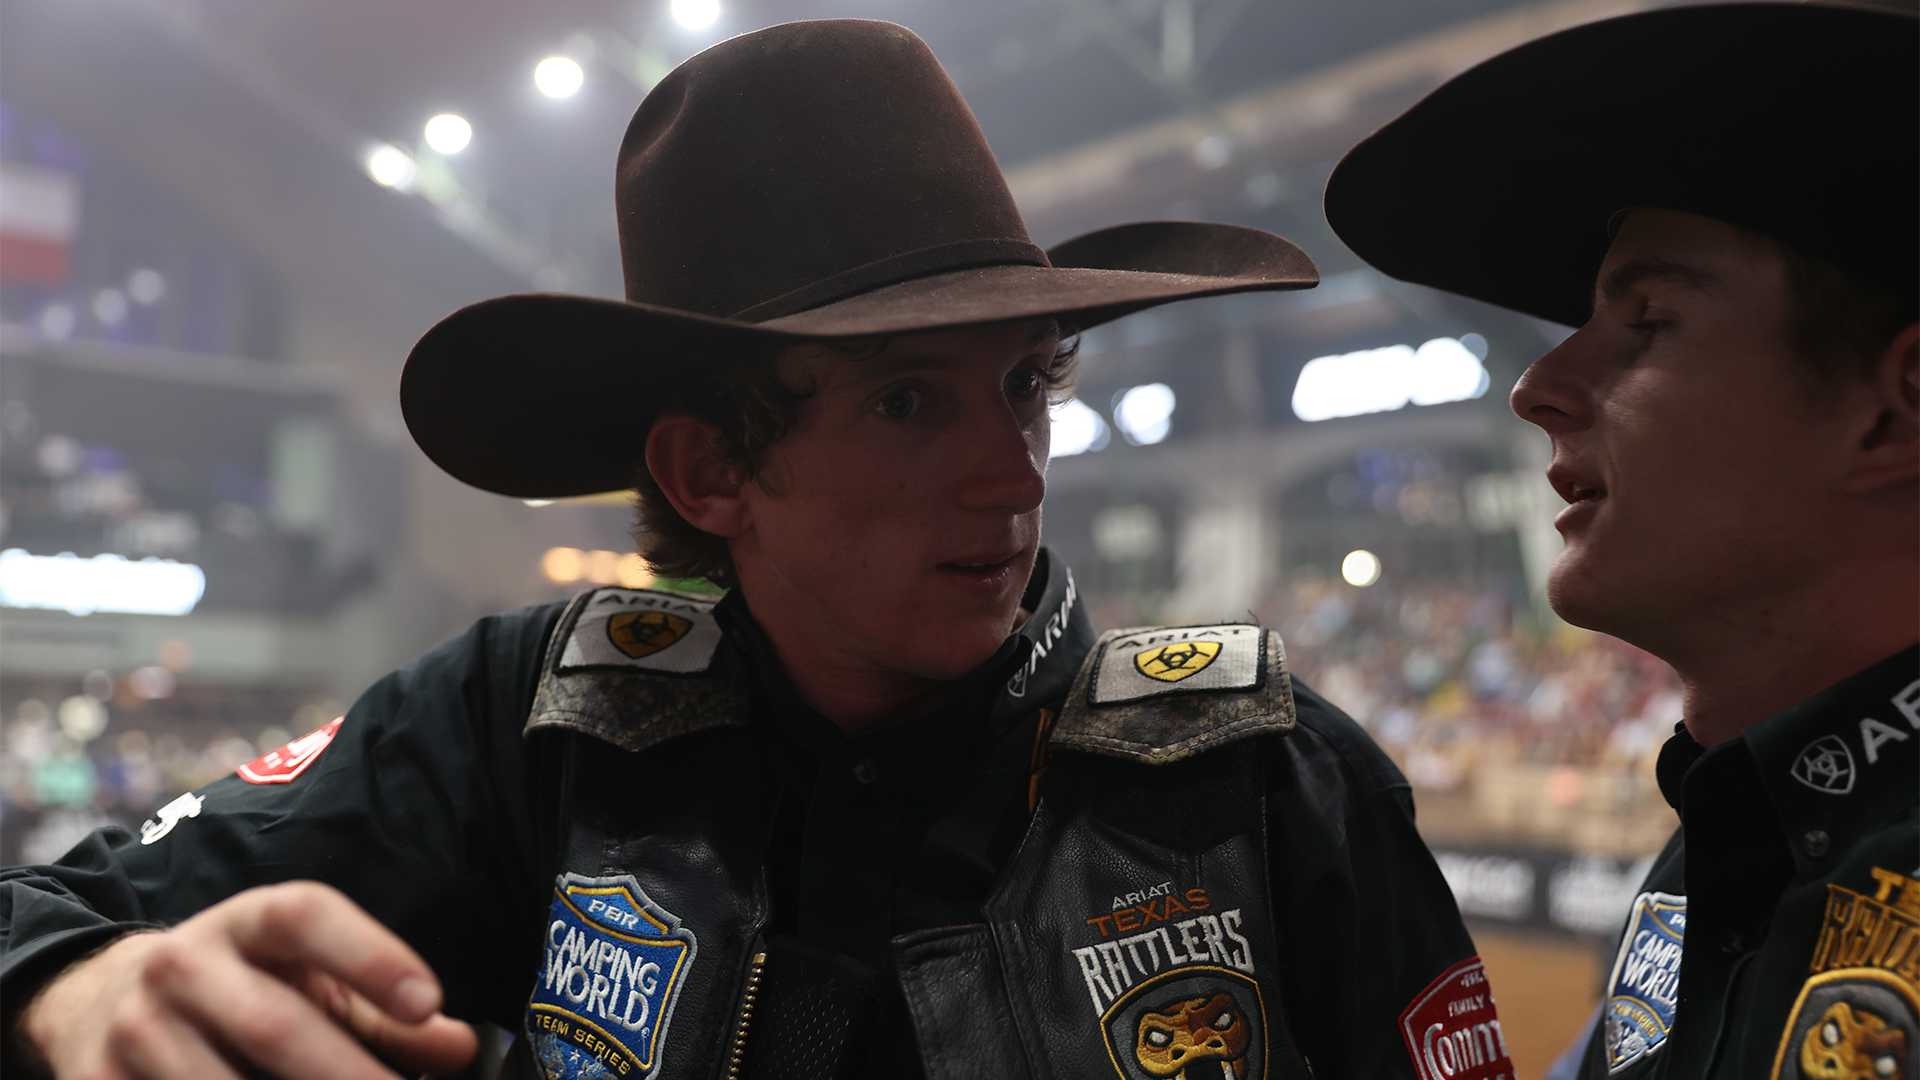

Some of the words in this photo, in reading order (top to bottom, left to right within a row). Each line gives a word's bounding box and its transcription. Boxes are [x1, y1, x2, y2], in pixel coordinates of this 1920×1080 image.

[597, 593, 714, 614] ARIA
[1030, 566, 1077, 675] ARIA
[1116, 629, 1241, 651] ARIAT
[587, 899, 640, 930] PBR
[1087, 887, 1212, 938] TEXAS
[1111, 881, 1173, 911] ARIAT
[550, 919, 662, 997] CAMPING
[1071, 907, 1255, 1018] RATTLERS
[545, 948, 650, 1032] WORLD
[535, 1014, 570, 1036] TEAM
[573, 1027, 631, 1076] SERIES
[1423, 1020, 1510, 1080] Comm
